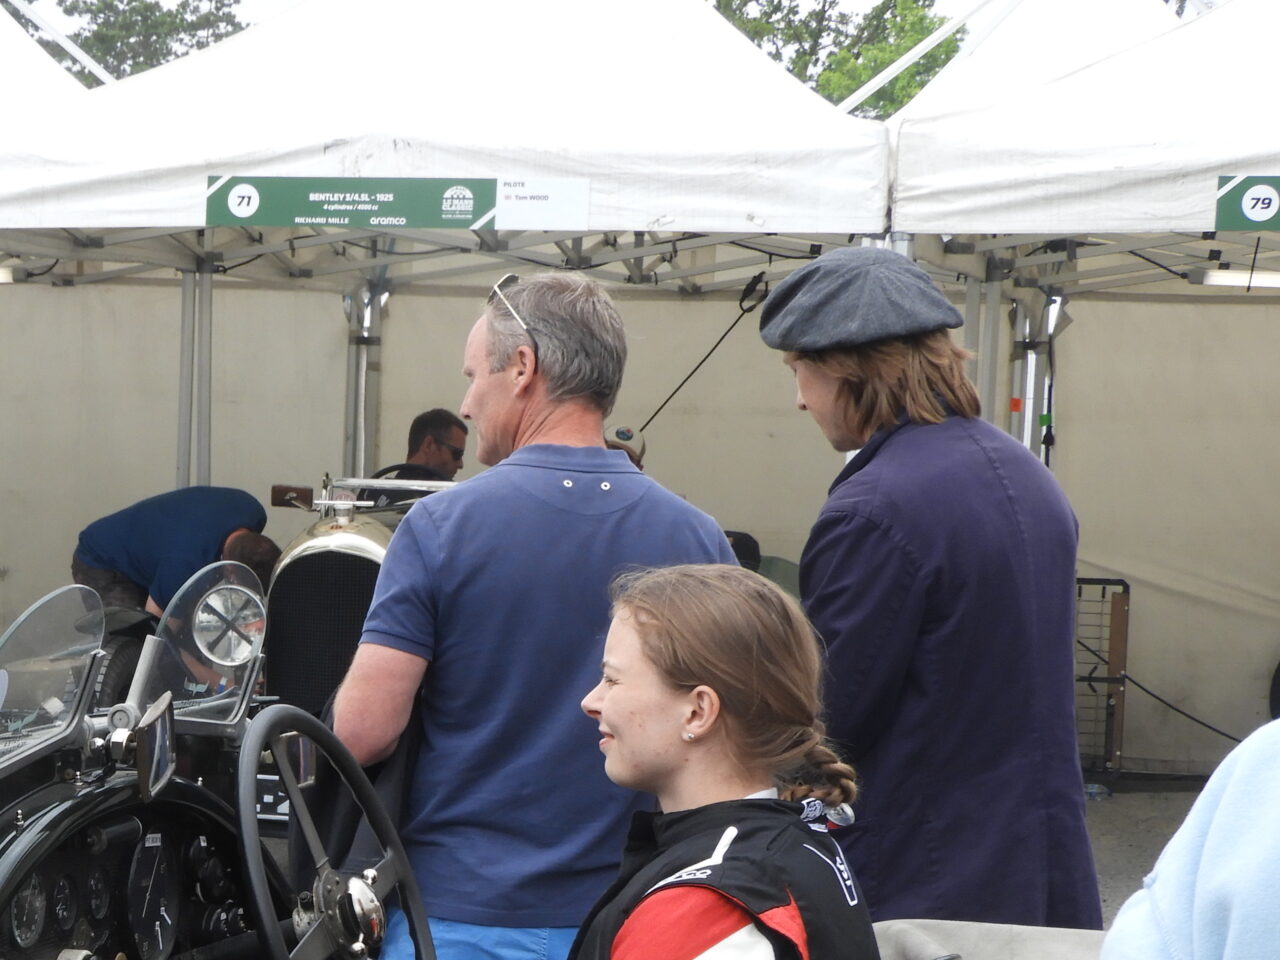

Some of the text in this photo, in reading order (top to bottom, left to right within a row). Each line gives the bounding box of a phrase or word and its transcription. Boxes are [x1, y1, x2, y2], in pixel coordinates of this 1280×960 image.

[237, 195, 252, 207] 71
[309, 192, 344, 201] BENTLEY
[1250, 197, 1273, 210] 79
[370, 217, 406, 225] aramco
